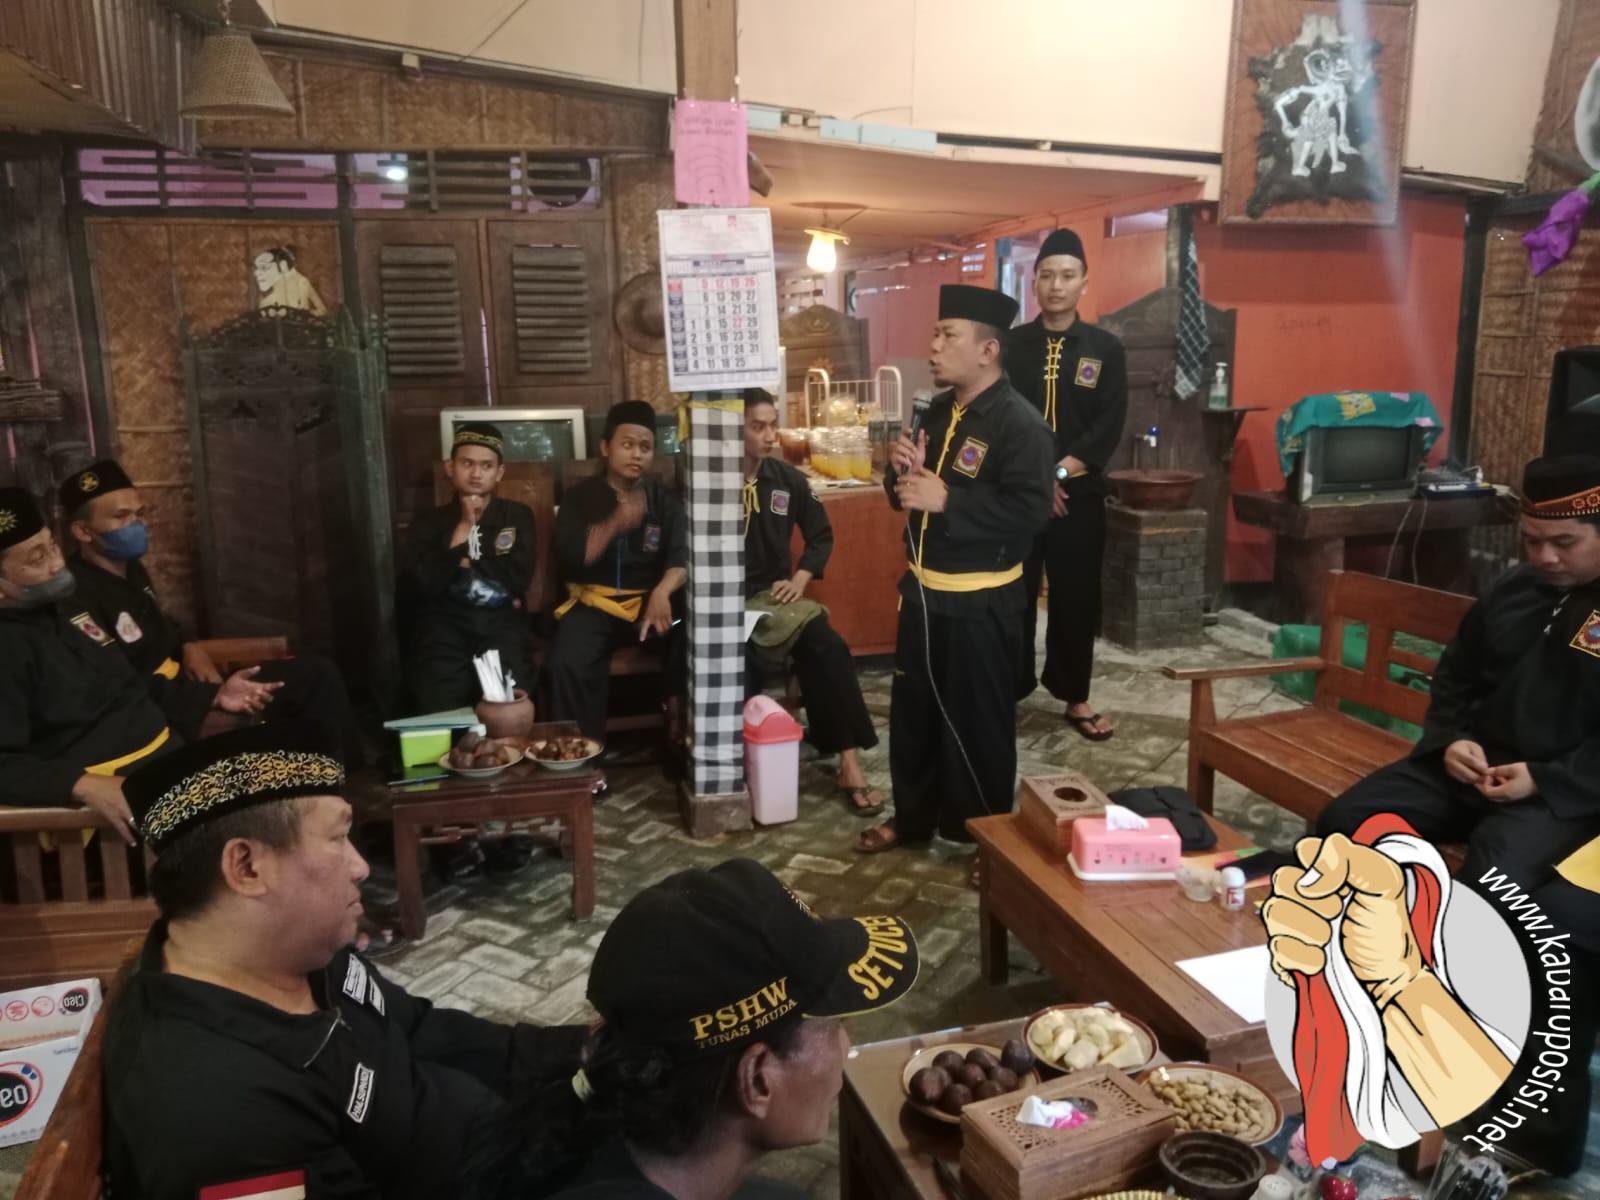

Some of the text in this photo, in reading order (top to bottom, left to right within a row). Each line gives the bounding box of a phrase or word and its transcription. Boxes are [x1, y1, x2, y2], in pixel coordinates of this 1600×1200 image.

[717, 278, 724, 289] 12
[745, 277, 755, 288] 26
[717, 292, 725, 302] 13
[731, 291, 741, 301] 20
[746, 290, 755, 300] 27
[718, 305, 726, 314] 14
[732, 305, 741, 315] 21
[747, 304, 757, 314] 28
[719, 319, 728, 329] 15
[733, 318, 742, 328] 22
[747, 317, 758, 327] 29
[720, 332, 728, 341] 16
[733, 331, 744, 341] 23
[748, 330, 759, 341] 30
[706, 345, 715, 355] 10
[721, 345, 728, 354] 17
[734, 344, 744, 354] 24
[750, 344, 759, 353] 31
[707, 359, 715, 369] 11
[722, 359, 730, 368] 18
[736, 358, 746, 367] 25
[63, 994, 85, 1008] Cleo
[690, 976, 788, 1041] PSHW
[698, 999, 798, 1049] TUNAS MUDA
